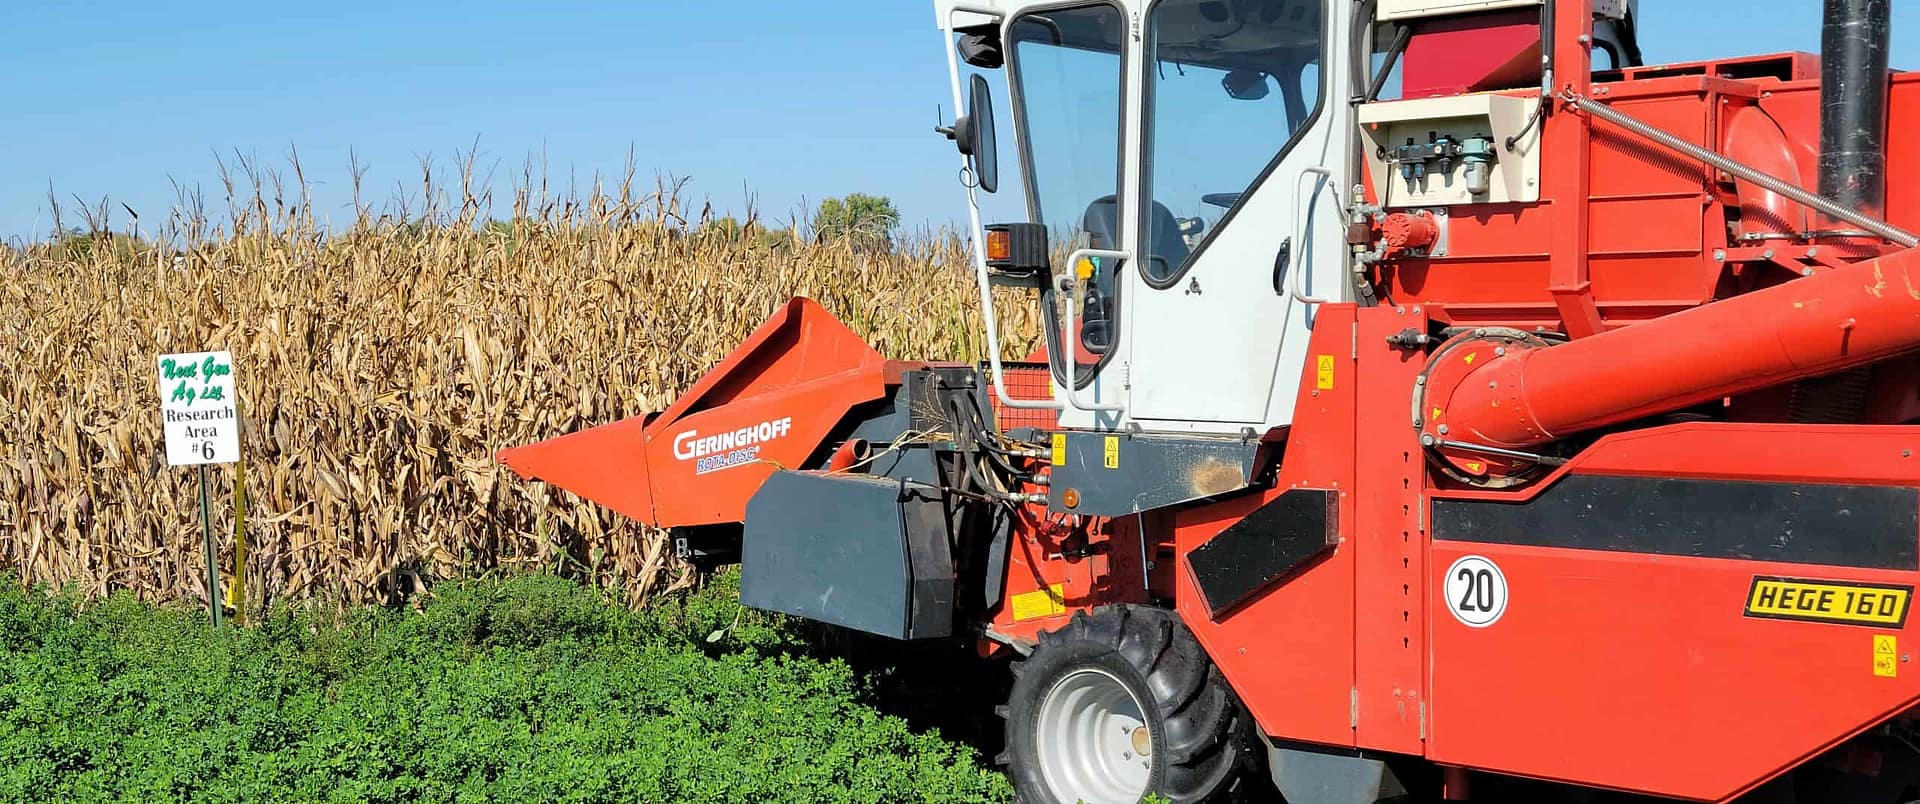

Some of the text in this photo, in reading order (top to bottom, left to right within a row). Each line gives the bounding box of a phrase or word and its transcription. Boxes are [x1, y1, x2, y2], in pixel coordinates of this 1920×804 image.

[161, 355, 230, 384] Next Gen
[171, 380, 196, 407] Ag
[166, 405, 233, 422] Research
[185, 425, 217, 438] Area
[673, 417, 792, 460] GERINGHOFF
[1458, 568, 1493, 612] 20
[1758, 586, 1898, 616] HEGE 160
